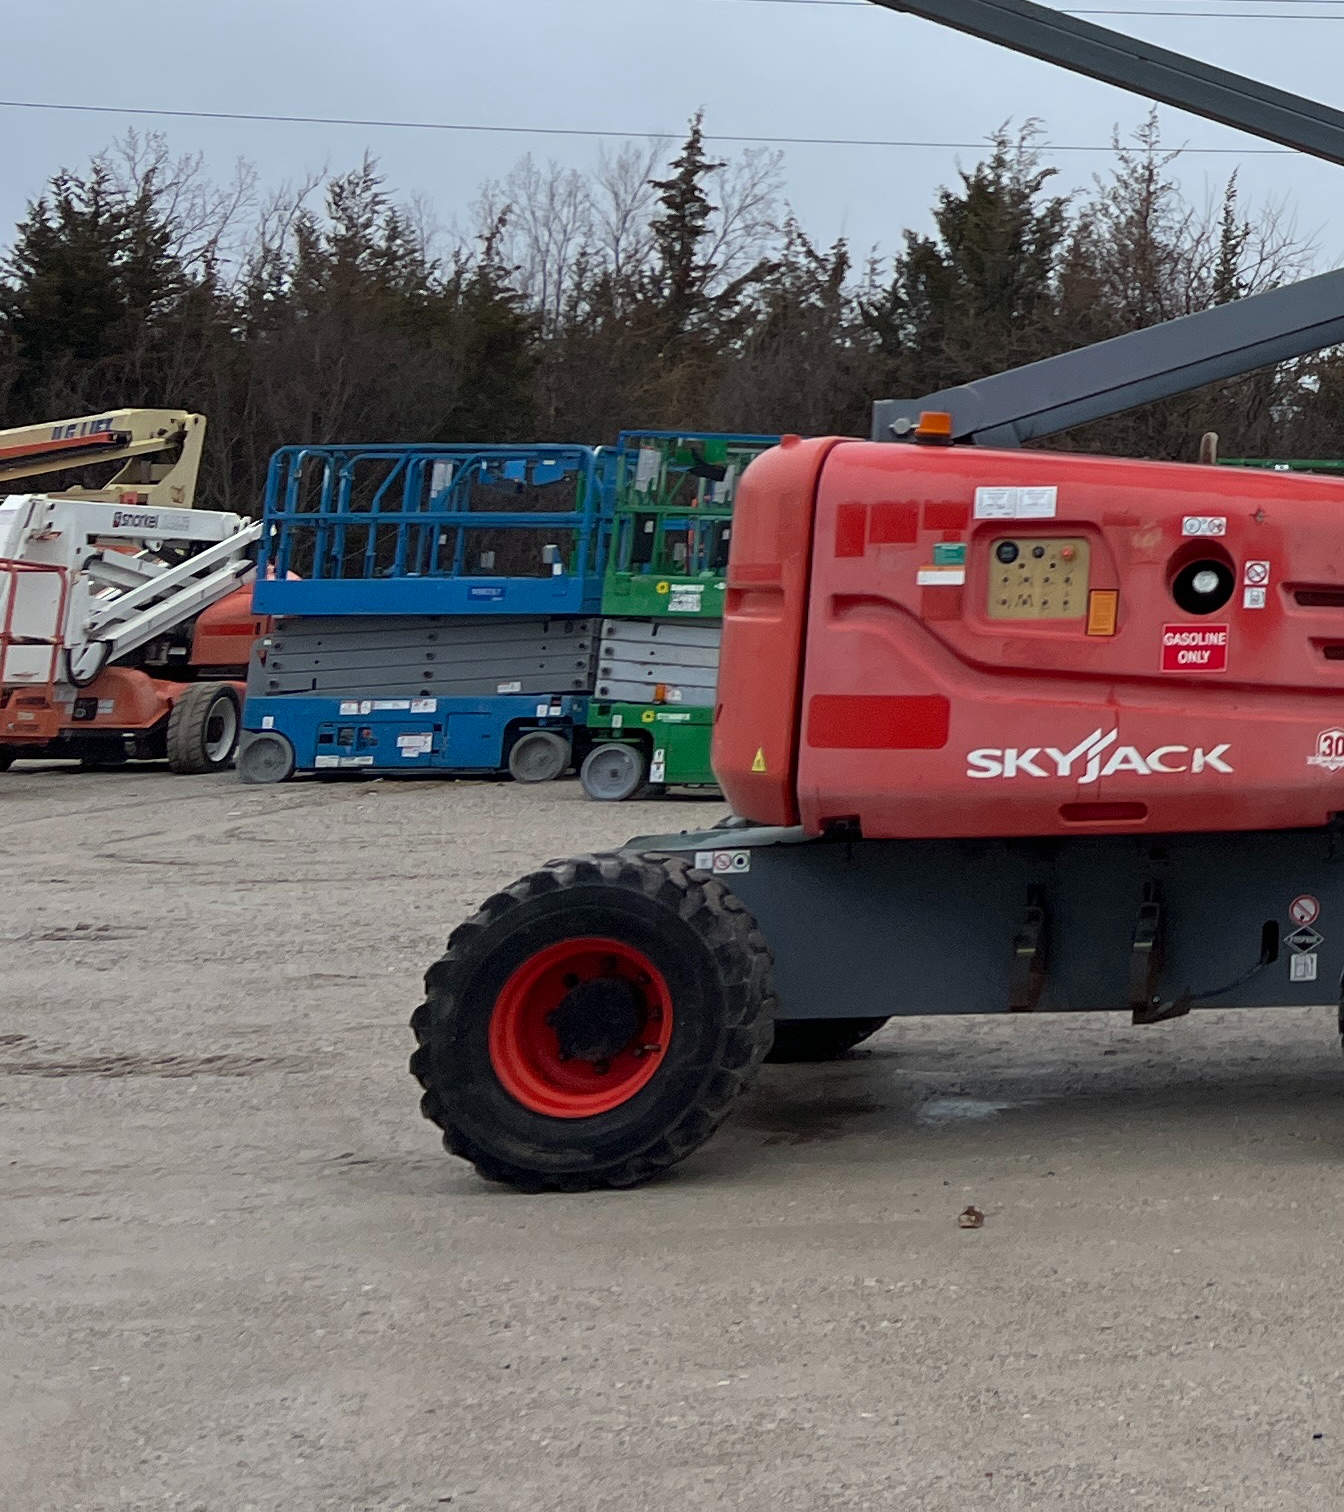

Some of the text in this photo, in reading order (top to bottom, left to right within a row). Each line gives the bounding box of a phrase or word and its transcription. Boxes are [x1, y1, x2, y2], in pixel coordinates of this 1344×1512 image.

[1163, 631, 1227, 647] GASOLINE
[1176, 650, 1211, 664] ONLY
[966, 727, 1236, 784] SKYJACK
